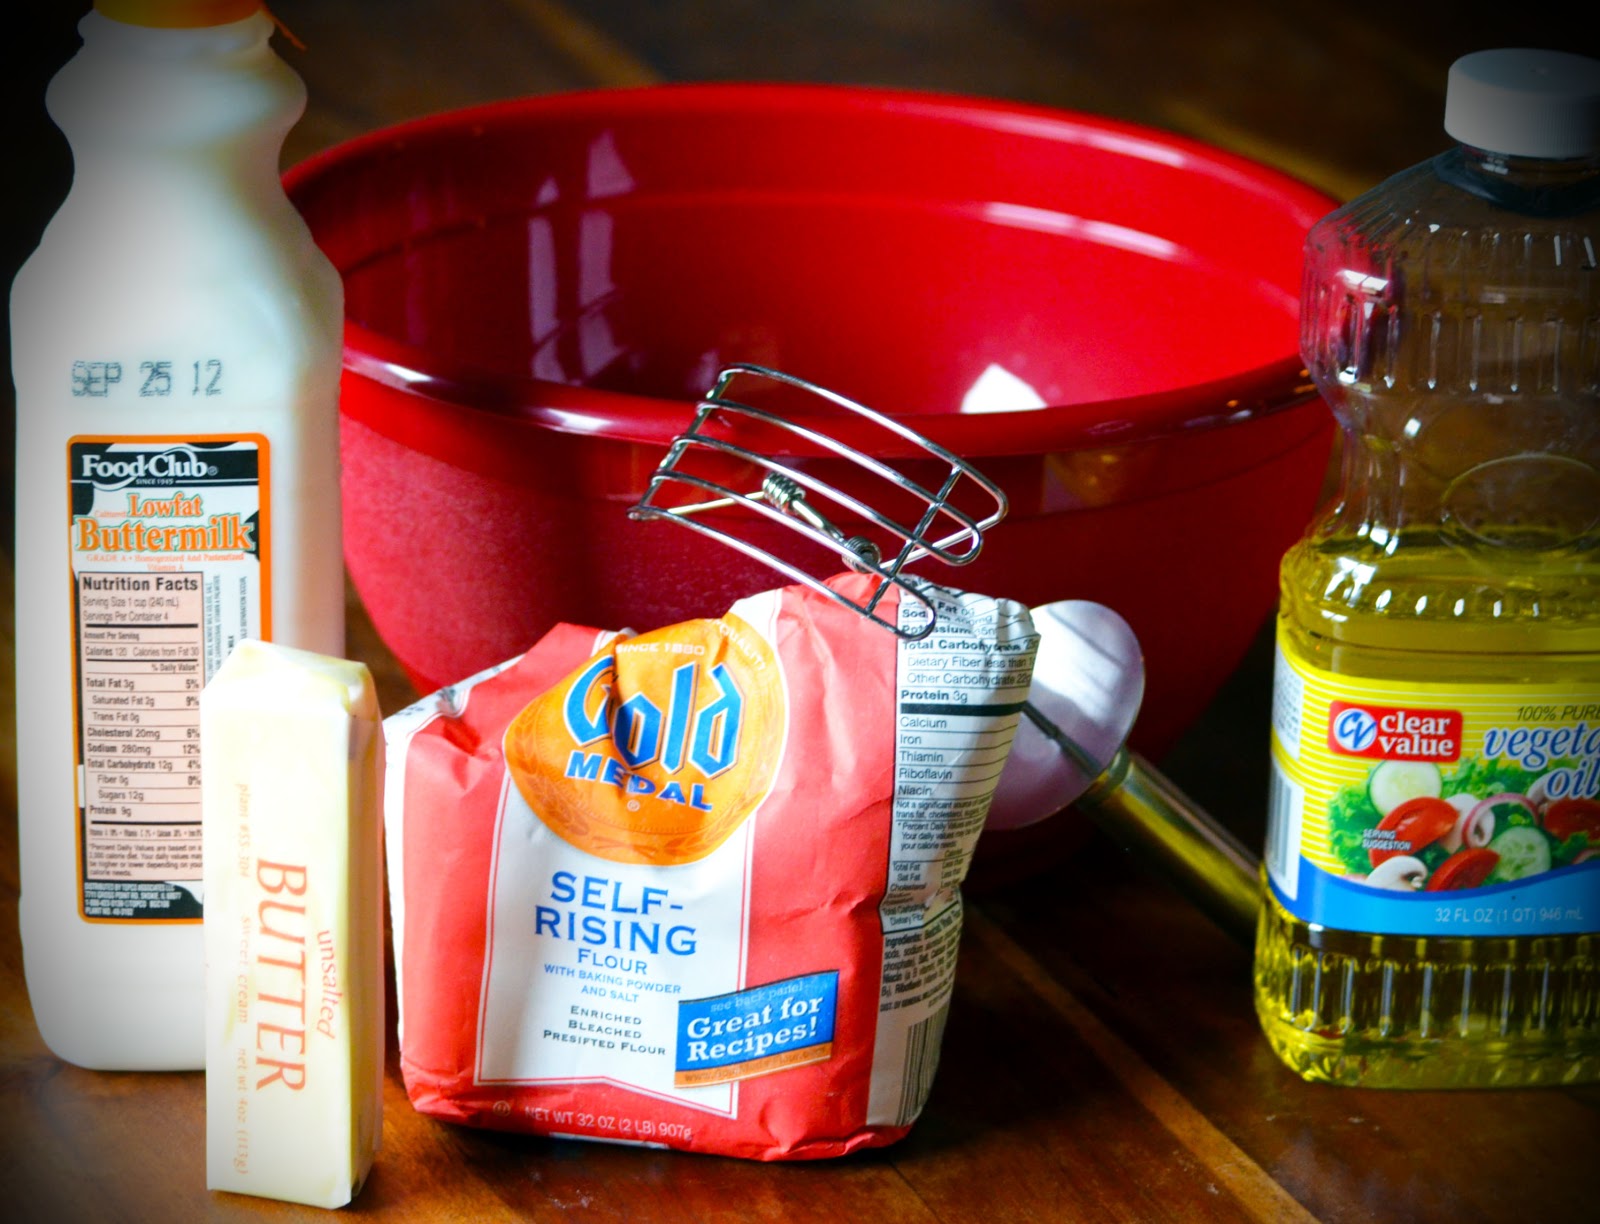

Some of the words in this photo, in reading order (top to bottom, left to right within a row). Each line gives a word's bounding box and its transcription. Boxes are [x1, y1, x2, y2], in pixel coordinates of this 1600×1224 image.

[72, 360, 122, 397] SEP
[140, 361, 172, 397] 25
[192, 359, 222, 395] 12
[128, 493, 202, 517] Lowfat
[77, 515, 253, 551] Buttermilk
[83, 577, 150, 590] Nutrition
[156, 577, 198, 590] Facts
[83, 597, 108, 608] Serving
[111, 597, 126, 607] Size
[128, 598, 132, 606] 1
[135, 599, 146, 608] cup
[938, 602, 958, 614] Fat
[83, 612, 112, 623] Servings
[115, 612, 127, 621] Per
[130, 612, 162, 621] Container
[164, 612, 168, 620] 4
[119, 632, 139, 640] Serving
[86, 647, 113, 656] Calories
[133, 647, 159, 656] Calories
[161, 647, 176, 656] from
[178, 647, 189, 655] Fat
[616, 642, 662, 654] SINCE
[719, 623, 766, 672] QUALITY
[902, 640, 934, 650] Total
[160, 664, 176, 673] Daily
[908, 657, 949, 670] Dietary
[952, 657, 981, 667] Fiber
[984, 657, 1006, 668] less
[1008, 657, 1026, 667] than
[86, 678, 105, 687] Total
[108, 679, 121, 687] Fat
[123, 680, 134, 690] 3g
[186, 679, 199, 689] 5%
[907, 672, 940, 683] Other
[943, 672, 1015, 688] Carbohydrate
[92, 696, 129, 704] Saturated
[131, 696, 143, 704] Fat
[145, 697, 155, 707] 2g
[901, 690, 949, 700] Protein
[953, 691, 968, 704] 3g
[93, 712, 114, 721] Trans
[117, 712, 128, 721] Fat
[564, 654, 743, 778] Gold
[1517, 705, 1557, 721] 100%
[900, 717, 947, 728] Calcium
[1380, 712, 1450, 735] clear
[88, 728, 132, 737] Cholesterol
[136, 729, 160, 739] 20mg
[900, 735, 922, 744] Iron
[87, 744, 117, 752] Sodium
[122, 745, 151, 755] 280mg
[1380, 734, 1454, 757] value
[900, 751, 943, 762] Thiamin
[88, 759, 104, 768] Total
[107, 760, 155, 770] Carbohydrate
[159, 760, 172, 771] 12g
[98, 775, 117, 784] Fiber
[899, 767, 952, 780] Riboflavin
[1546, 758, 1600, 797] oil
[564, 750, 712, 812] MEDAL
[98, 790, 126, 801] Sugars
[128, 791, 144, 801] 12g
[898, 785, 932, 795] Niacin
[90, 805, 117, 815] Protein
[121, 807, 131, 817] 9g
[918, 801, 952, 810] significant
[903, 822, 929, 830] Percent
[1362, 828, 1396, 840] SERVING
[901, 842, 916, 851] your
[1362, 839, 1411, 850] SUGGESTION
[894, 862, 908, 871] Total
[910, 863, 920, 871] Fat
[910, 873, 920, 881] Fat
[550, 871, 684, 915] SELF-
[1434, 908, 1451, 922] 32
[1454, 908, 1471, 922] FL
[1473, 908, 1493, 922] OZ
[1539, 908, 1561, 922] 946
[534, 905, 698, 956] RISING
[239, 915, 251, 966] sweet
[577, 947, 648, 975] FLOUR
[255, 857, 308, 1091] BUTTER
[544, 964, 575, 978] WITH
[579, 970, 623, 986] BAKING
[626, 979, 682, 995] POWDER
[316, 929, 343, 1040] unsalted
[237, 974, 248, 1024] cream
[581, 985, 606, 998] AND
[610, 990, 639, 1003] SALT
[570, 1005, 642, 1025] ENRICHED
[687, 1003, 773, 1039] Great
[780, 997, 824, 1020] for
[568, 1019, 642, 1039] BLEACHED
[543, 1030, 615, 1050] PRESIFTED
[621, 1041, 666, 1056] FLOUR
[687, 1016, 817, 1062] Recipes!
[237, 1048, 247, 1073] net
[525, 1106, 550, 1121] NET
[552, 1111, 574, 1124] WT
[578, 1112, 595, 1127] 32
[598, 1115, 615, 1129] OZ
[619, 1119, 631, 1132] (2
[635, 1120, 656, 1135] LB)
[658, 1123, 692, 1141] 907g
